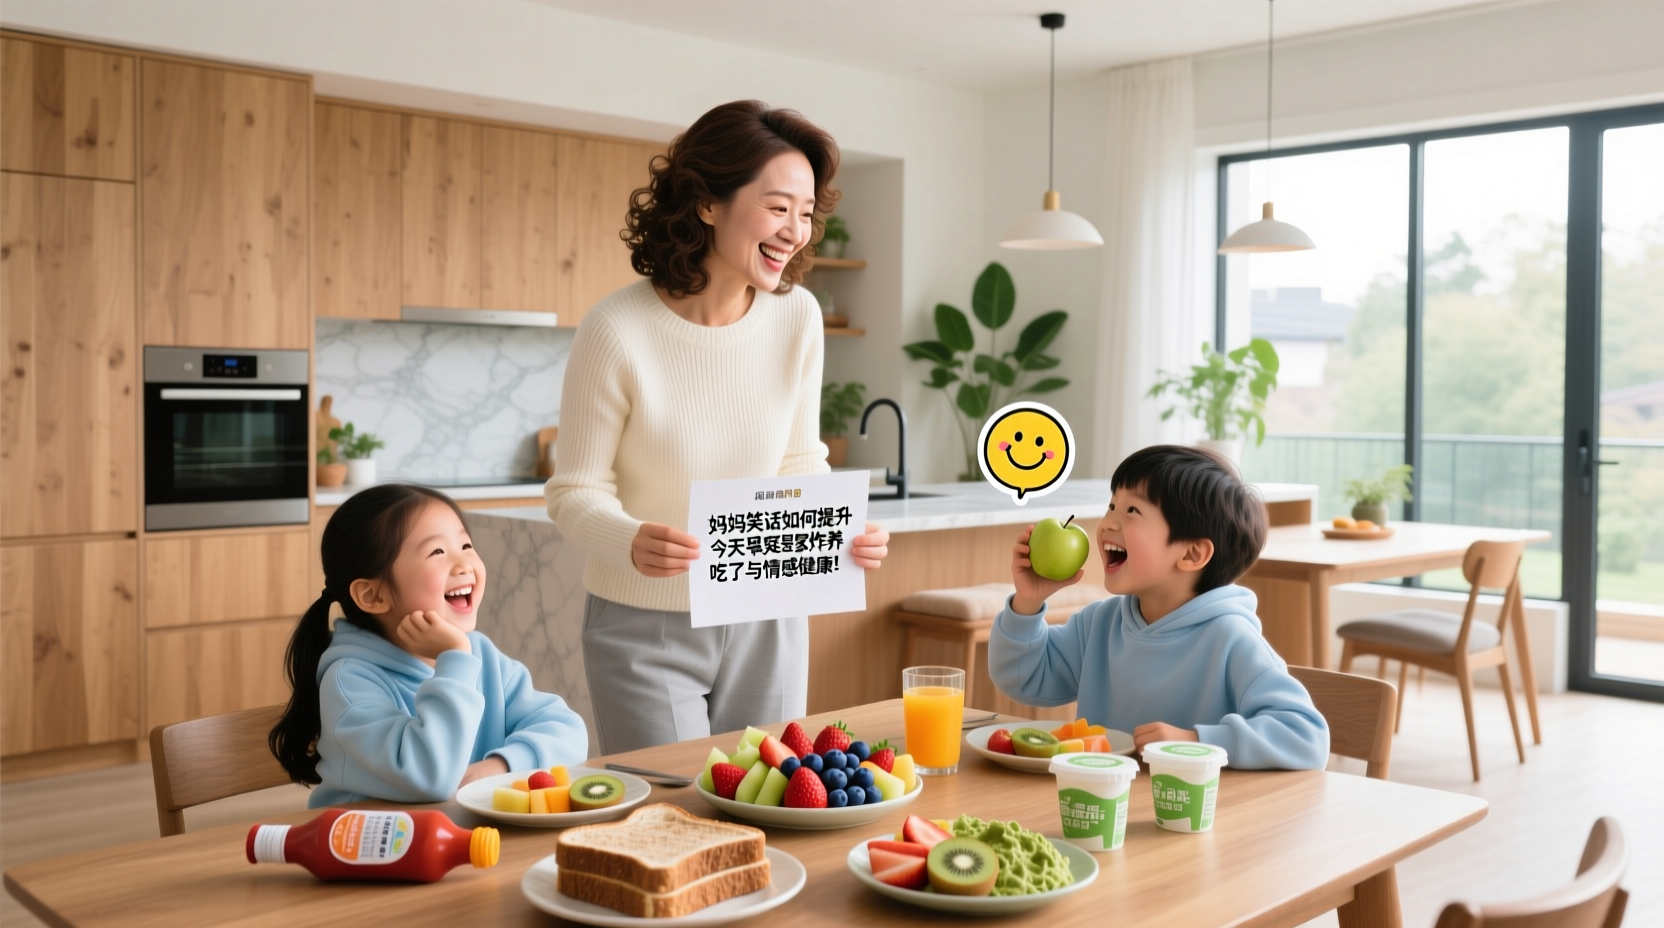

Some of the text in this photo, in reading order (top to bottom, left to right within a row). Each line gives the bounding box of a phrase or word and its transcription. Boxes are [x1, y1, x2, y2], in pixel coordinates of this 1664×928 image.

[708, 506, 853, 534] 妈妈笑话如何提升
